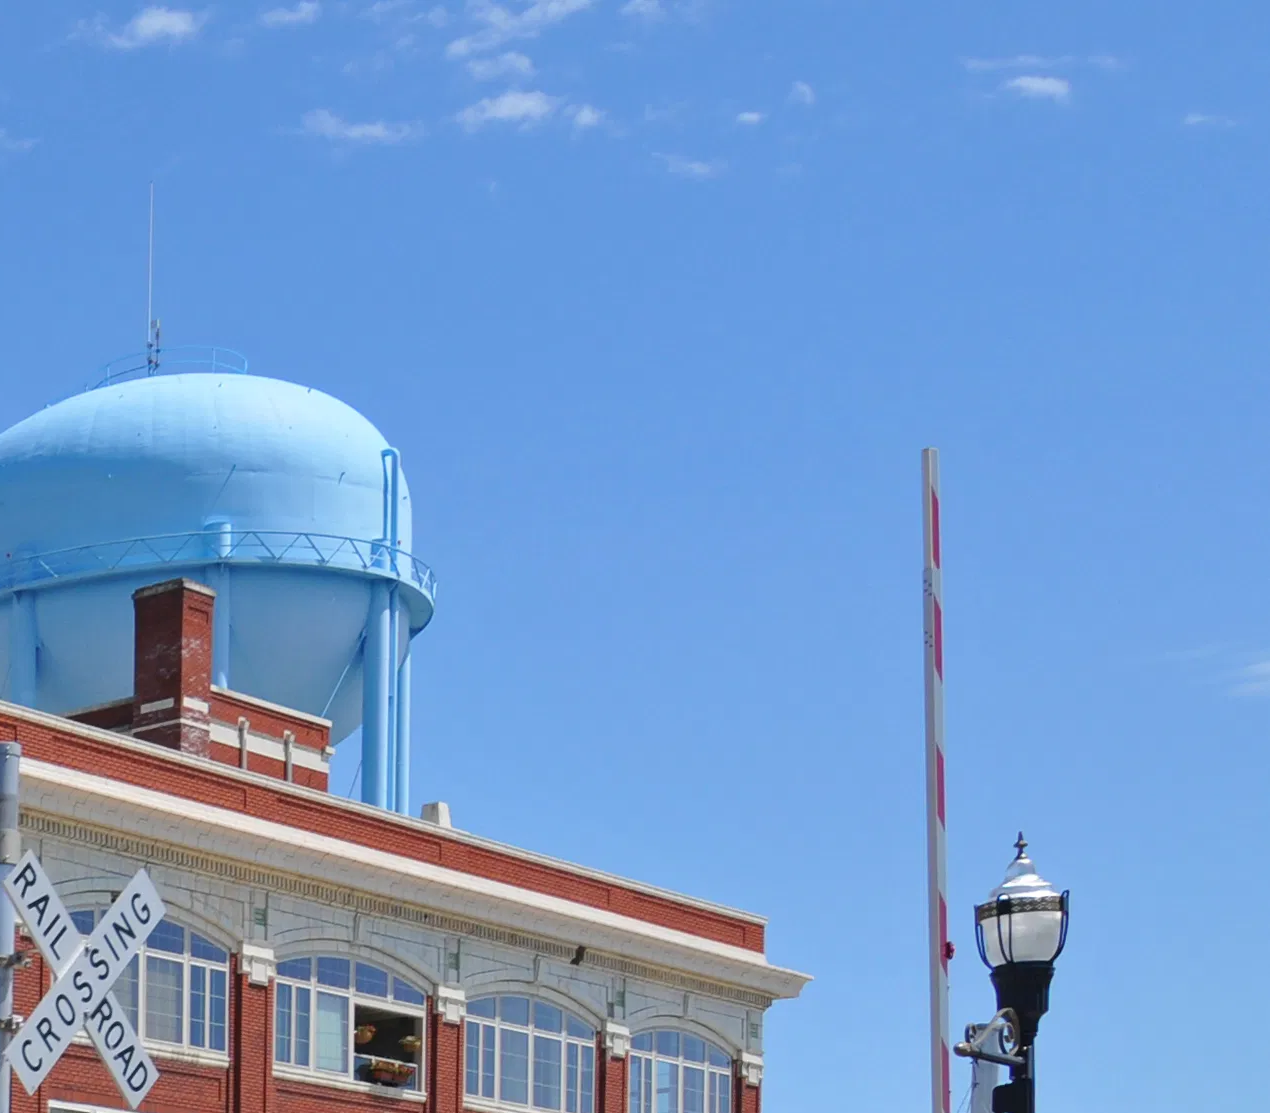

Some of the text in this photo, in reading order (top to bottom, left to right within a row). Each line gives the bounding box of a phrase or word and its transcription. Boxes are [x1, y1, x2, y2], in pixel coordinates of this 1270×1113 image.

[13, 861, 69, 961] RAIL
[21, 892, 152, 1073] CROSSING
[90, 997, 149, 1093] ROAD
